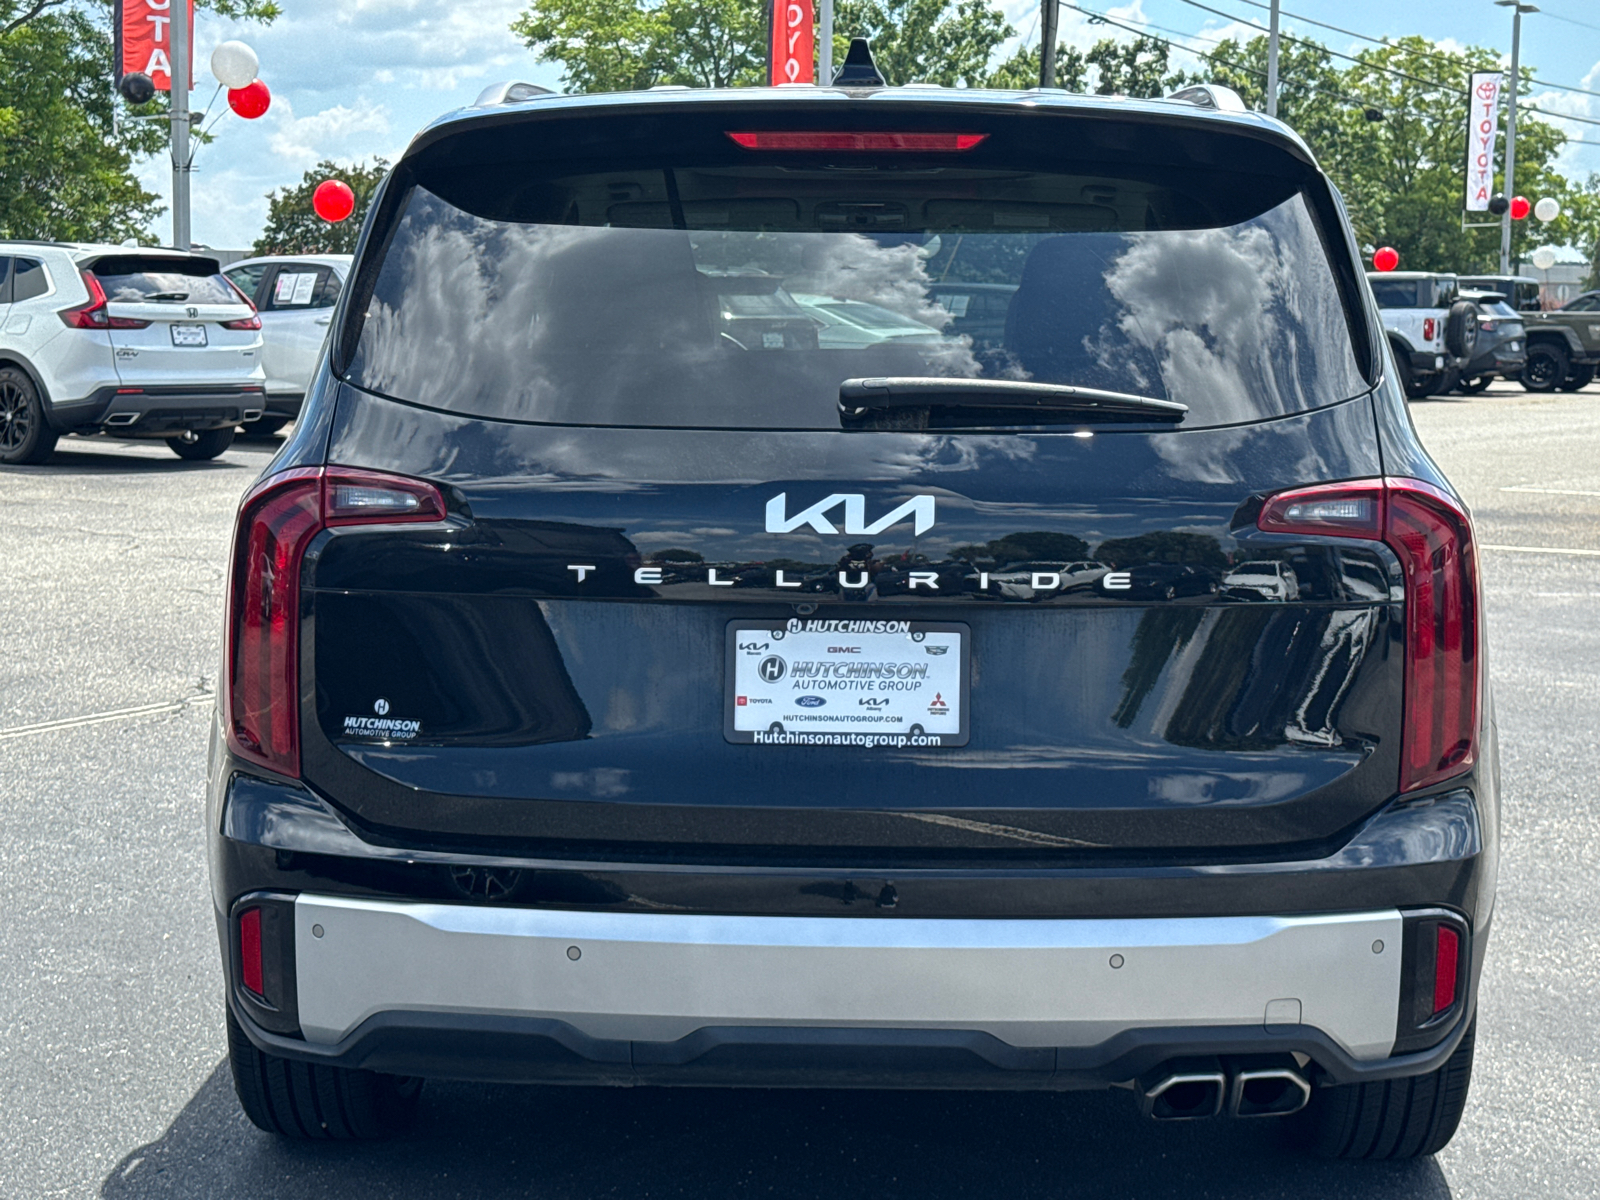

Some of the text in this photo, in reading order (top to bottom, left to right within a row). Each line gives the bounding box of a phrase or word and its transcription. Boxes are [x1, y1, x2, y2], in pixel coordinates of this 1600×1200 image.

[1476, 103, 1493, 200] TOYOTA
[765, 492, 935, 537] KIA
[567, 565, 1133, 589] TELLURIDE
[805, 619, 911, 634] HUTCHINSON
[739, 642, 770, 651] KIA
[827, 646, 862, 654] GMC
[790, 661, 926, 680] HUTCHINSON
[792, 679, 922, 692] AUTOMOTIVE GROUP
[858, 697, 890, 706] KIA
[344, 716, 420, 732] HUTCHINSON
[783, 714, 903, 723] HUTCHINSONAUTOGROUP.COM
[345, 728, 417, 739] AUTOMOTIVE GROUP
[753, 730, 941, 748] Hutchinsonautogroup.com
